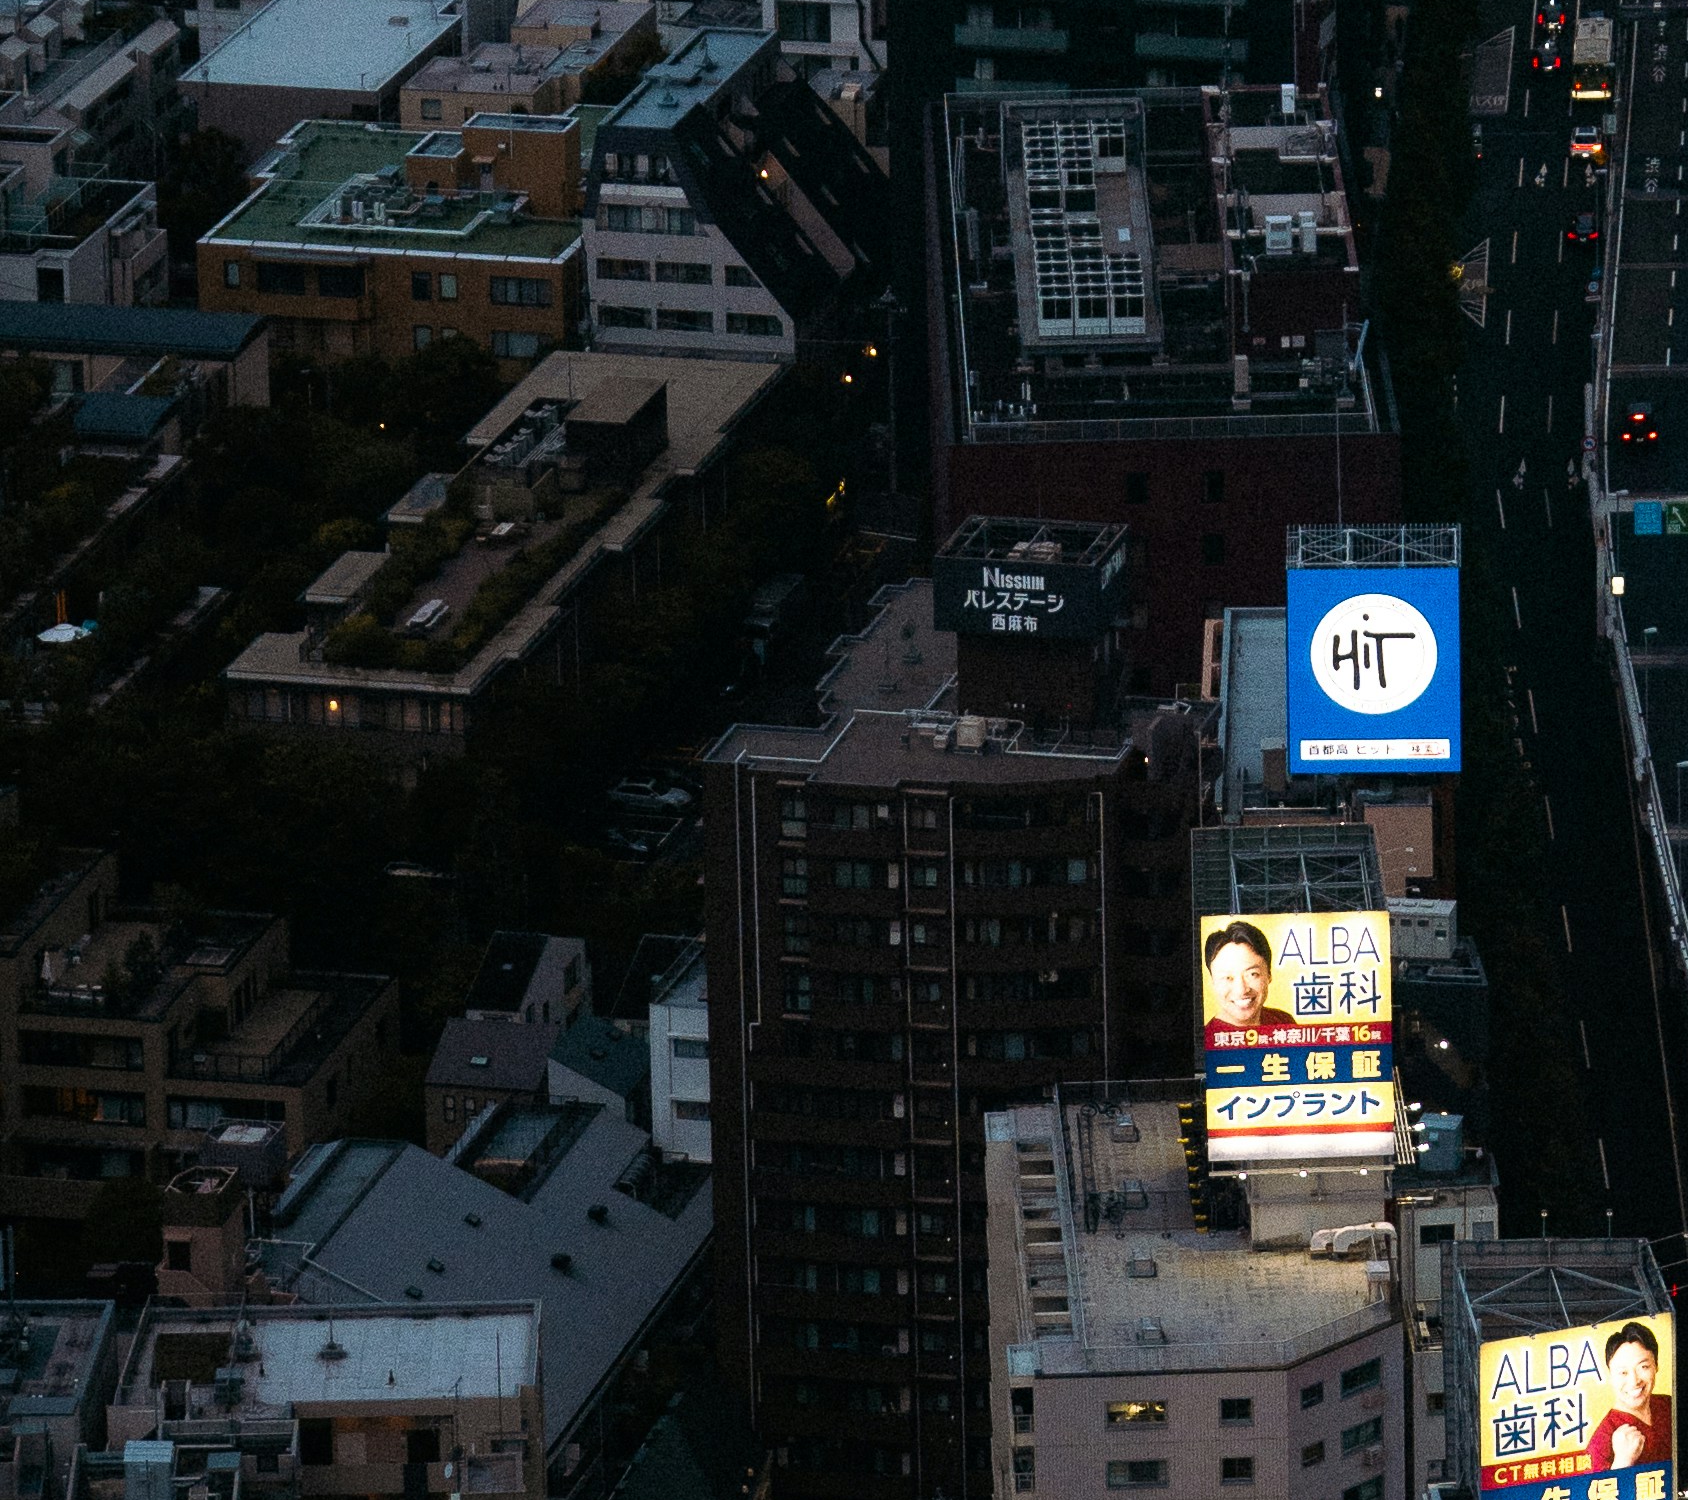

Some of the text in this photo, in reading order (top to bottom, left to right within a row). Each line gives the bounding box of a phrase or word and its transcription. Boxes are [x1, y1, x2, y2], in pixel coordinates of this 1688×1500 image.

[963, 589, 1065, 613] パレステージ
[991, 613, 1039, 632] 西麻布
[1308, 743, 1349, 756] 首都高
[1356, 744, 1395, 756] ヒット
[1278, 926, 1381, 966] ALBA
[1293, 969, 1382, 1016] 歯科
[1215, 1050, 1382, 1082] 一生保証
[1217, 1090, 1381, 1121] インプラント
[1491, 1340, 1603, 1400] ALBA
[1492, 1393, 1589, 1457] 歯科
[1493, 1453, 1593, 1485] CT無料相談
